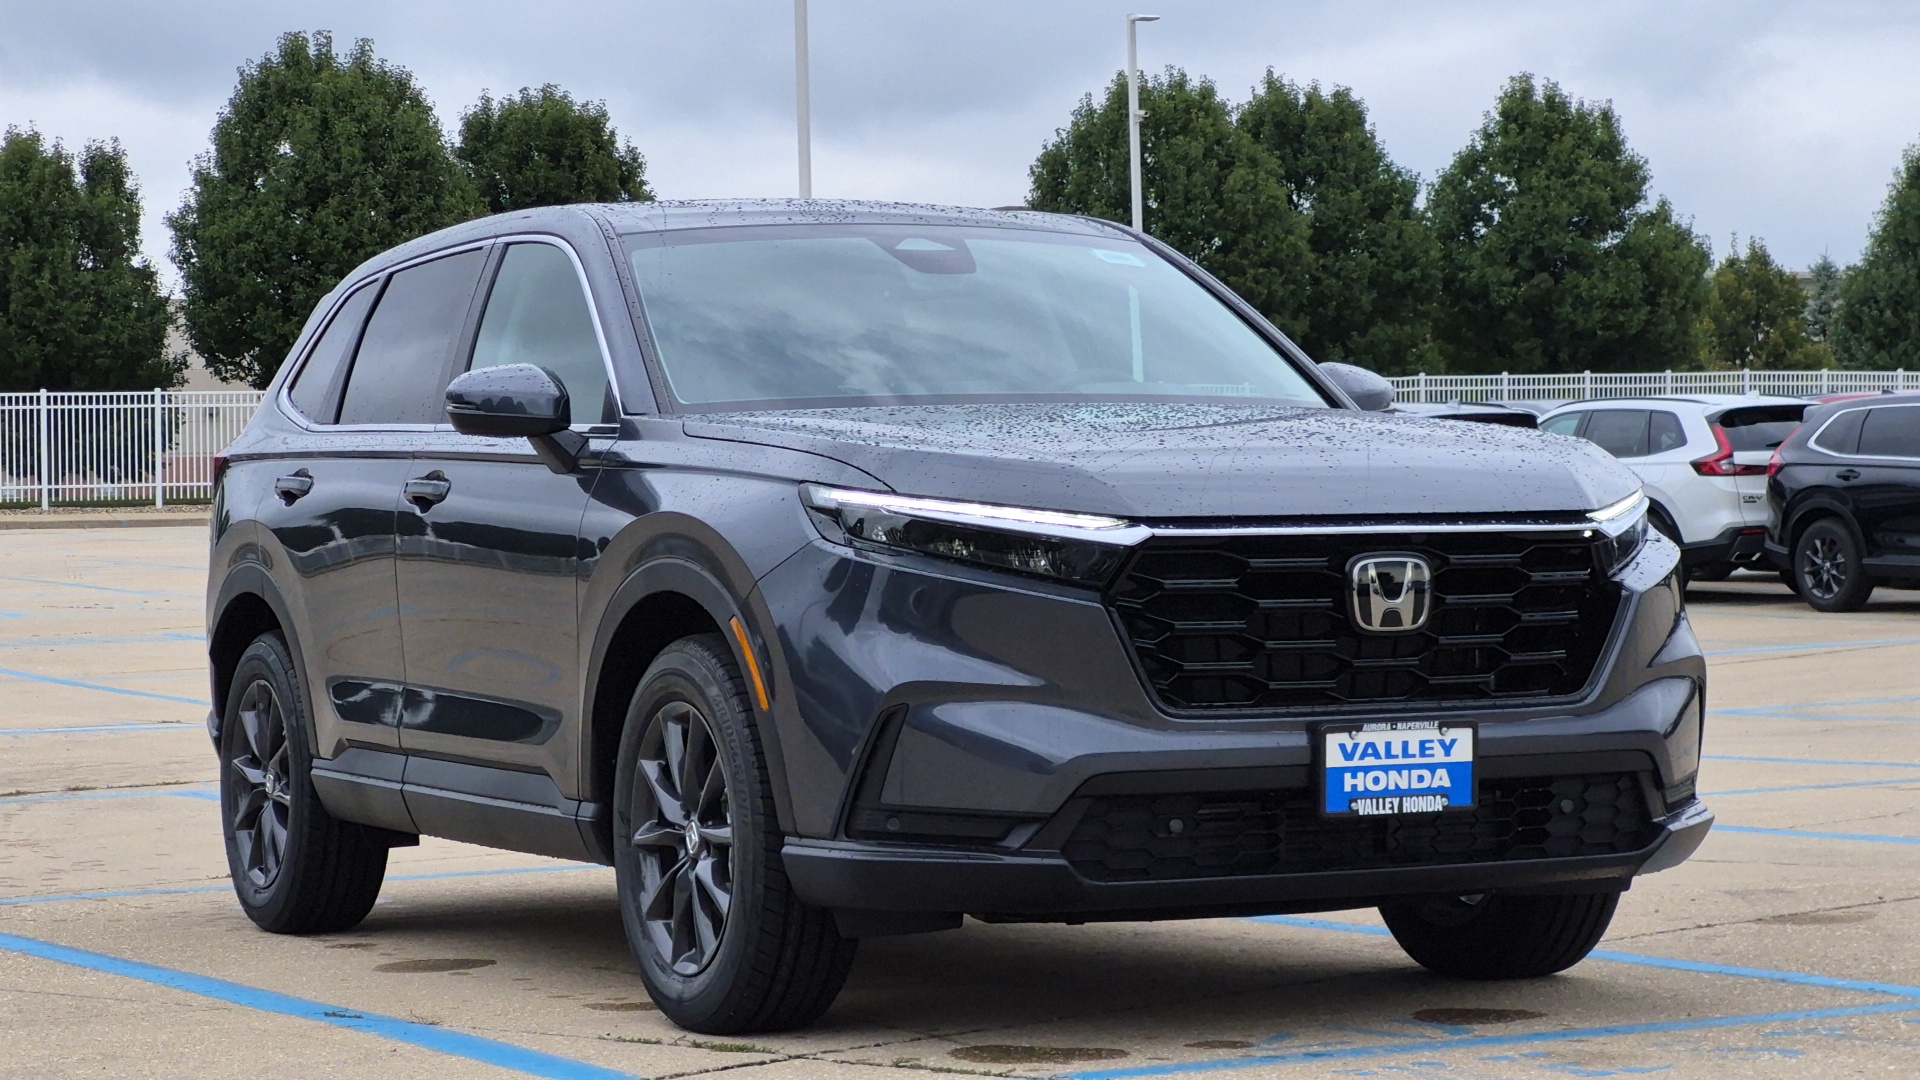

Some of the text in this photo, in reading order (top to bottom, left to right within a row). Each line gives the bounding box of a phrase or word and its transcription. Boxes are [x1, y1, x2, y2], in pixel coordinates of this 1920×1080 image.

[1362, 721, 1439, 732] AURORA NAPERVILLE
[1338, 738, 1458, 761] VALLEY
[1344, 768, 1451, 792] HONDA
[1357, 795, 1443, 816] VALLEY HONDA
